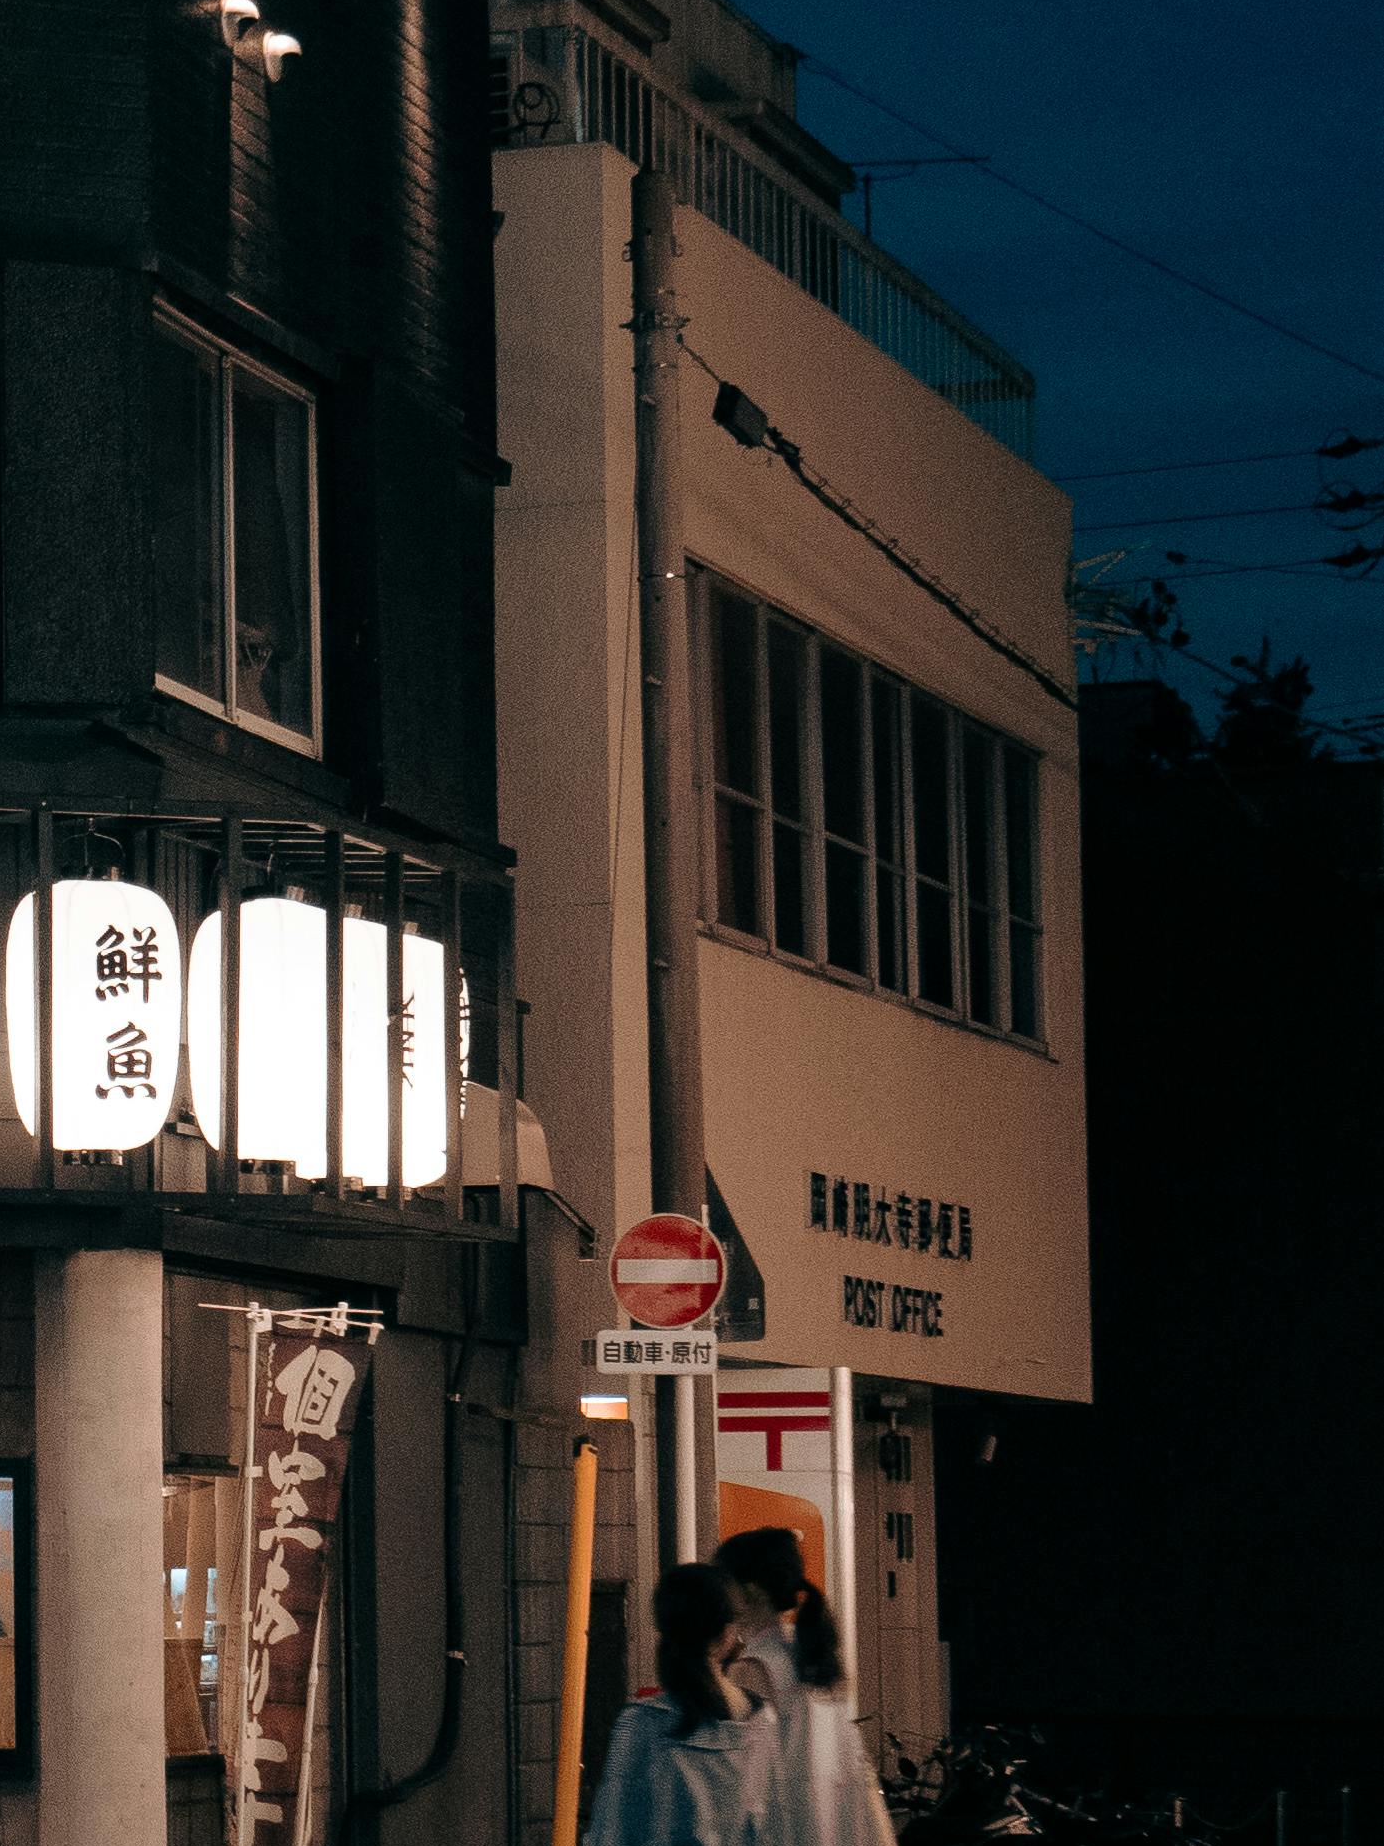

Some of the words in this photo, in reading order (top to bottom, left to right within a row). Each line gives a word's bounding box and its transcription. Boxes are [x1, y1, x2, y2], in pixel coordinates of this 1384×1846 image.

[94, 924, 163, 1102] 鮮魚
[843, 1274, 885, 1329] POST
[891, 1284, 944, 1338] OFFICE
